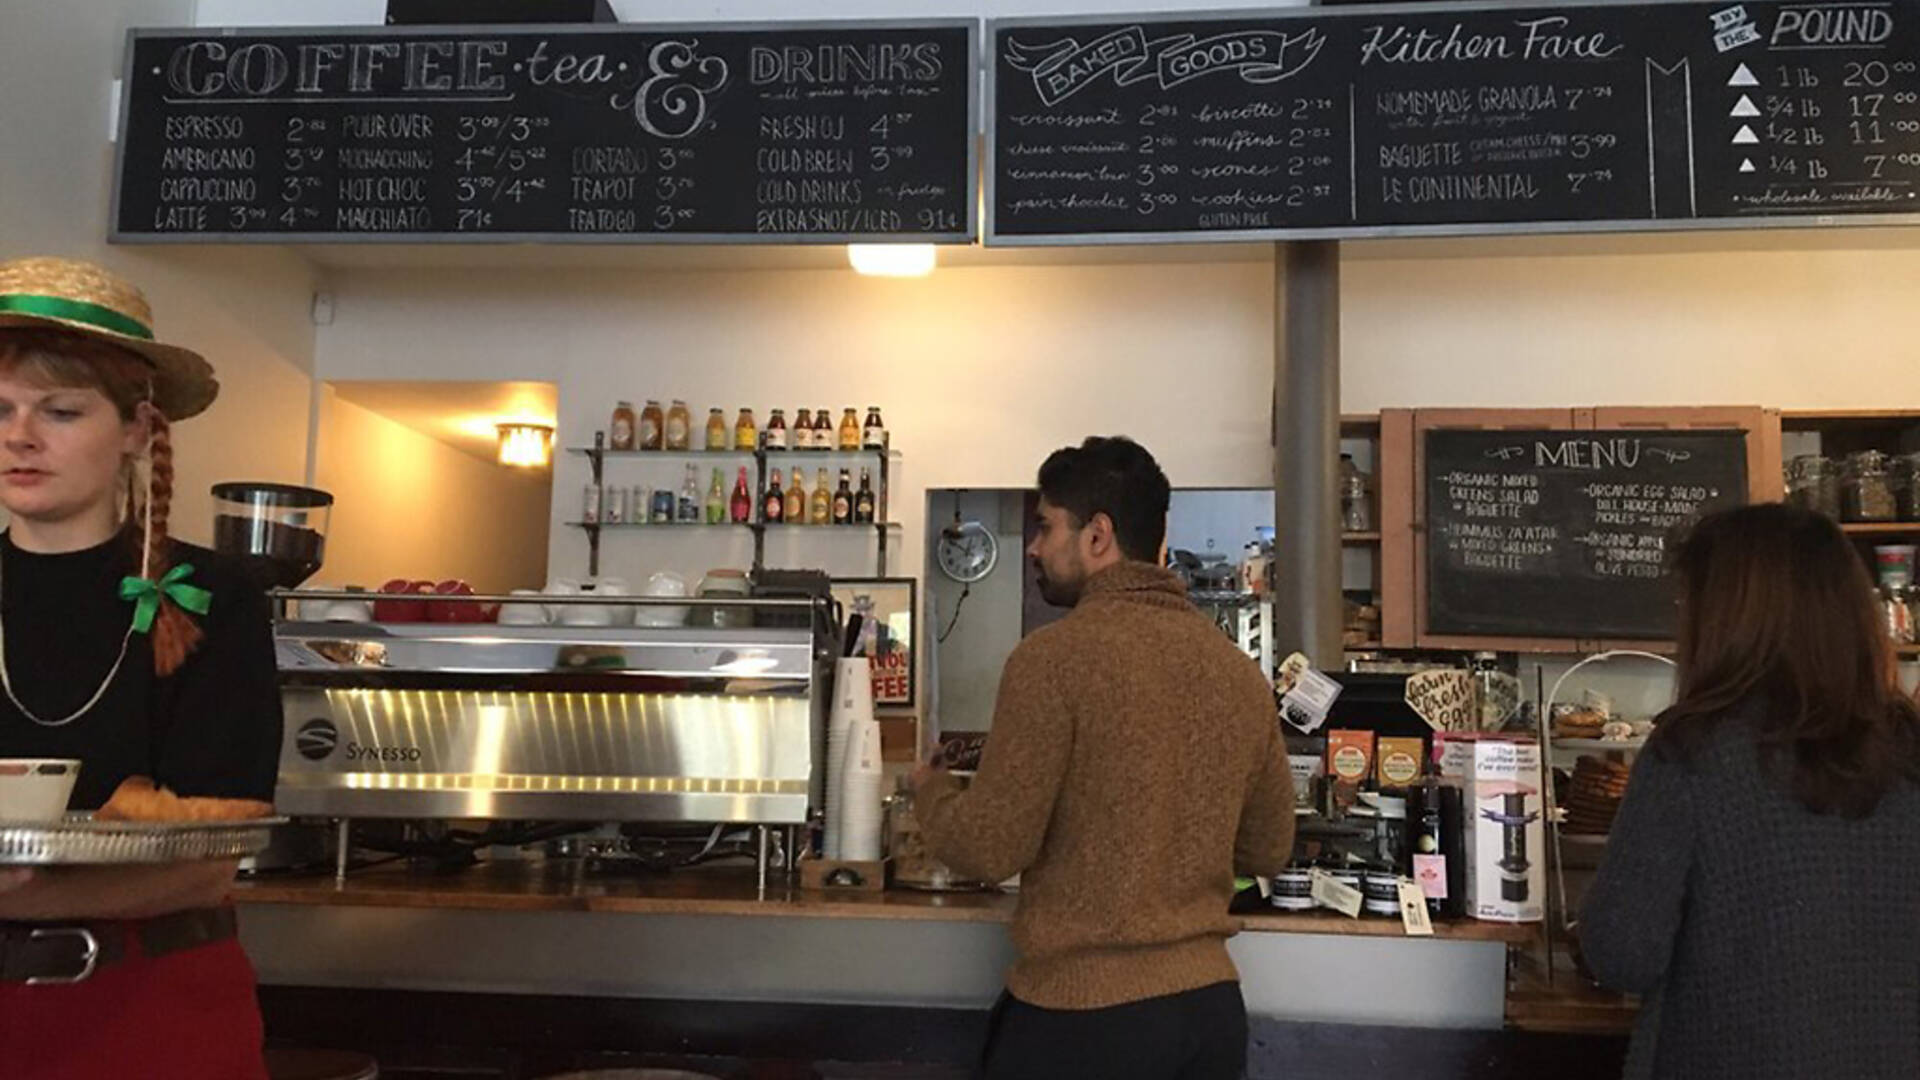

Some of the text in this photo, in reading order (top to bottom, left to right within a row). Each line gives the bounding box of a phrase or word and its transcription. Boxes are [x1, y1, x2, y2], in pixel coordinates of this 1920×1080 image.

[1720, 8, 1742, 23] BY
[1769, 9, 1893, 45] POUND
[1360, 16, 1625, 66] Kitchen Fare
[1720, 29, 1750, 48] THE
[167, 40, 508, 95] COFFEE
[529, 41, 614, 85] tea
[750, 43, 942, 84] DRINKS
[1047, 34, 1267, 96] BAKED GOODS
[1797, 67, 1819, 87] lb
[1376, 87, 1472, 116] HOMEMADE
[1477, 84, 1558, 113] GRANOLA
[1801, 98, 1821, 118] lb
[165, 115, 243, 141] ESPRESSO
[343, 113, 388, 139] POUR
[391, 113, 433, 139] OVER
[760, 115, 817, 141] FRESH
[820, 114, 845, 141] OJ
[1010, 107, 1125, 128] croissant
[1194, 130, 1283, 152] muffins
[1804, 126, 1824, 146] lb
[162, 147, 255, 172] AMERICANO
[757, 148, 800, 173] COLD
[804, 148, 854, 174] BREW
[1379, 141, 1463, 168] BAGUETTE
[1192, 164, 1279, 179] scones
[1808, 159, 1828, 179] lb
[160, 177, 257, 202] CAPPUCCINO
[339, 177, 374, 201] HOT
[377, 176, 427, 202] CHOC
[757, 179, 797, 204] COLD
[801, 178, 863, 205] DRINKS
[1192, 187, 1284, 209] cookies
[1382, 176, 1403, 203] LE
[1408, 173, 1540, 203] CONTINENTAL
[1742, 187, 1827, 205] wholesale
[154, 205, 208, 230] LATTE
[336, 207, 432, 231] MACCHIATO
[1535, 438, 1640, 470] MENU
[1499, 488, 1540, 505] SALAD
[1588, 482, 1639, 498] ORGANIC
[1669, 486, 1707, 501] SALAD
[871, 676, 908, 698] FEE
